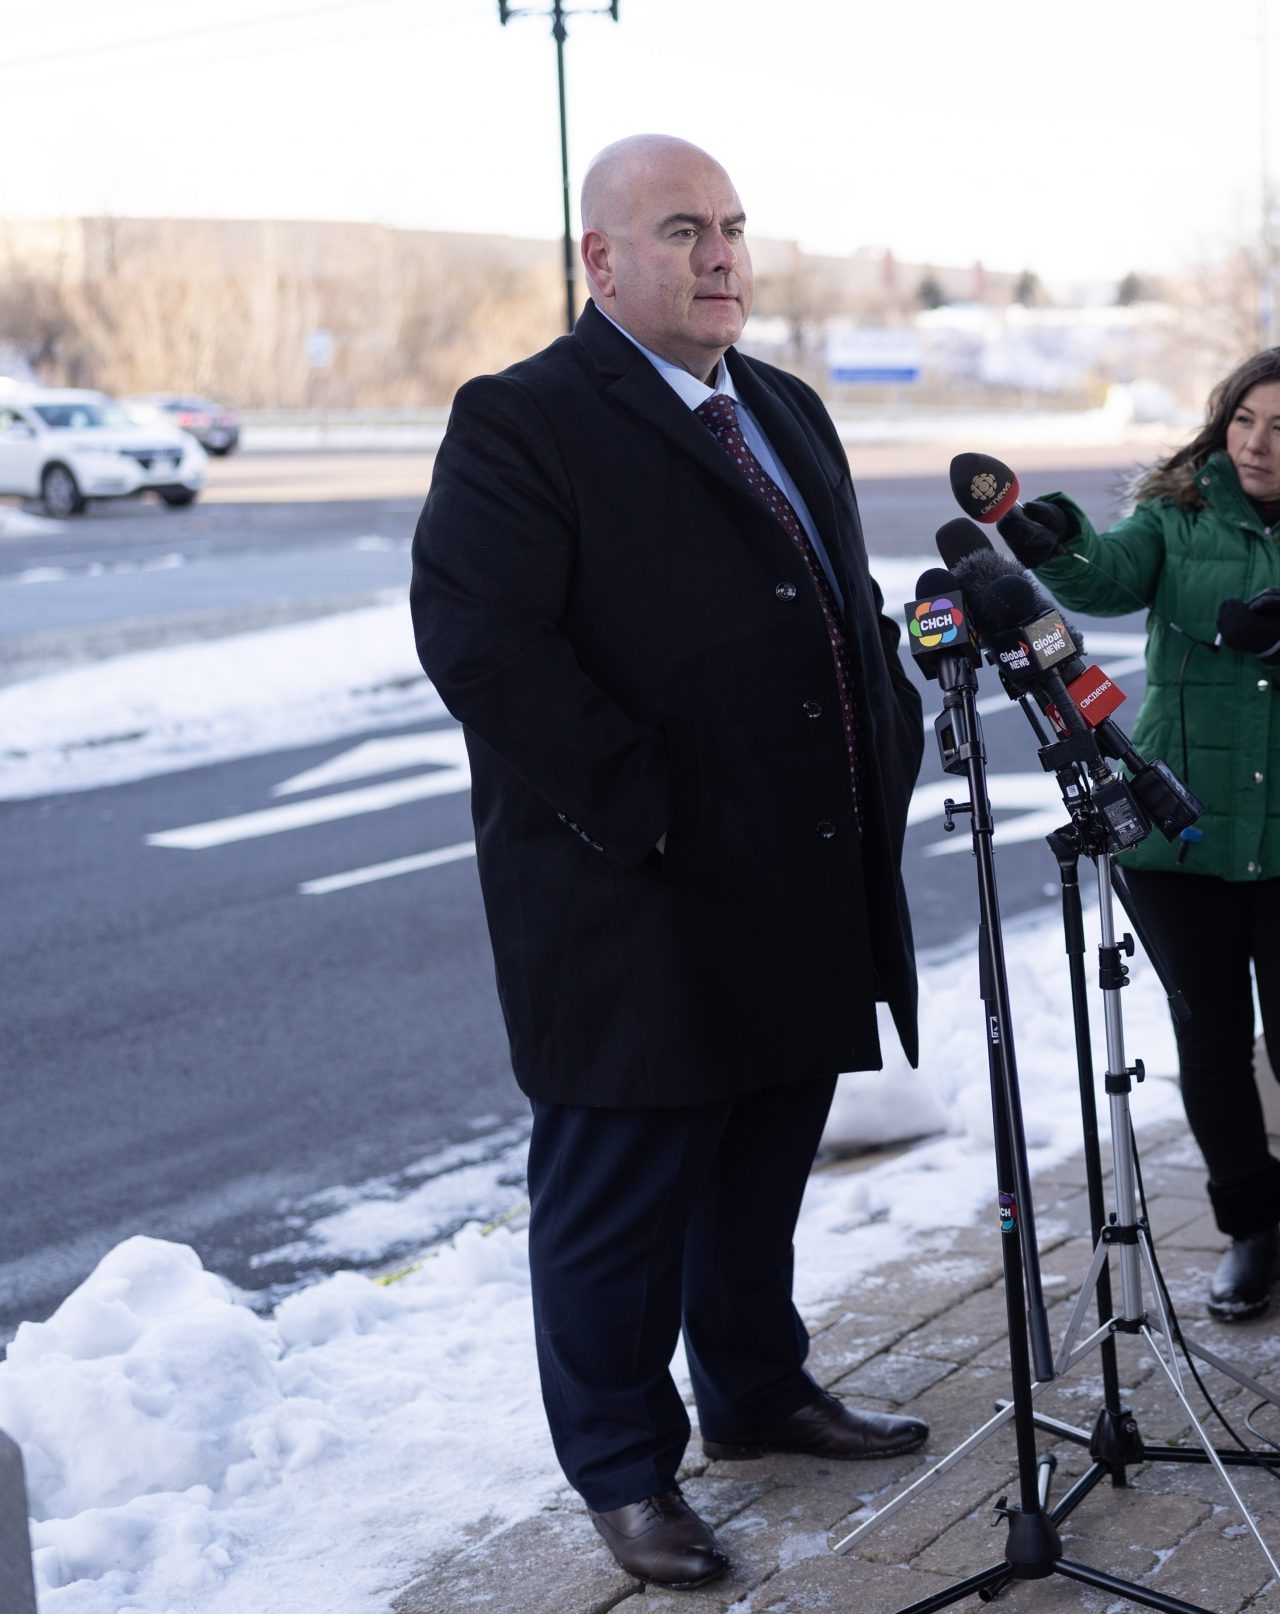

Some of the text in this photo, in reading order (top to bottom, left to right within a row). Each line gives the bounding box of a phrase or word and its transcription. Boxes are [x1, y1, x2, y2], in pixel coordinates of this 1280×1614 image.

[920, 614, 953, 631] CHCH
[1032, 628, 1062, 651] Global
[1043, 639, 1066, 657] NEWS
[999, 647, 1027, 663] Global
[1009, 657, 1030, 671] NEWS
